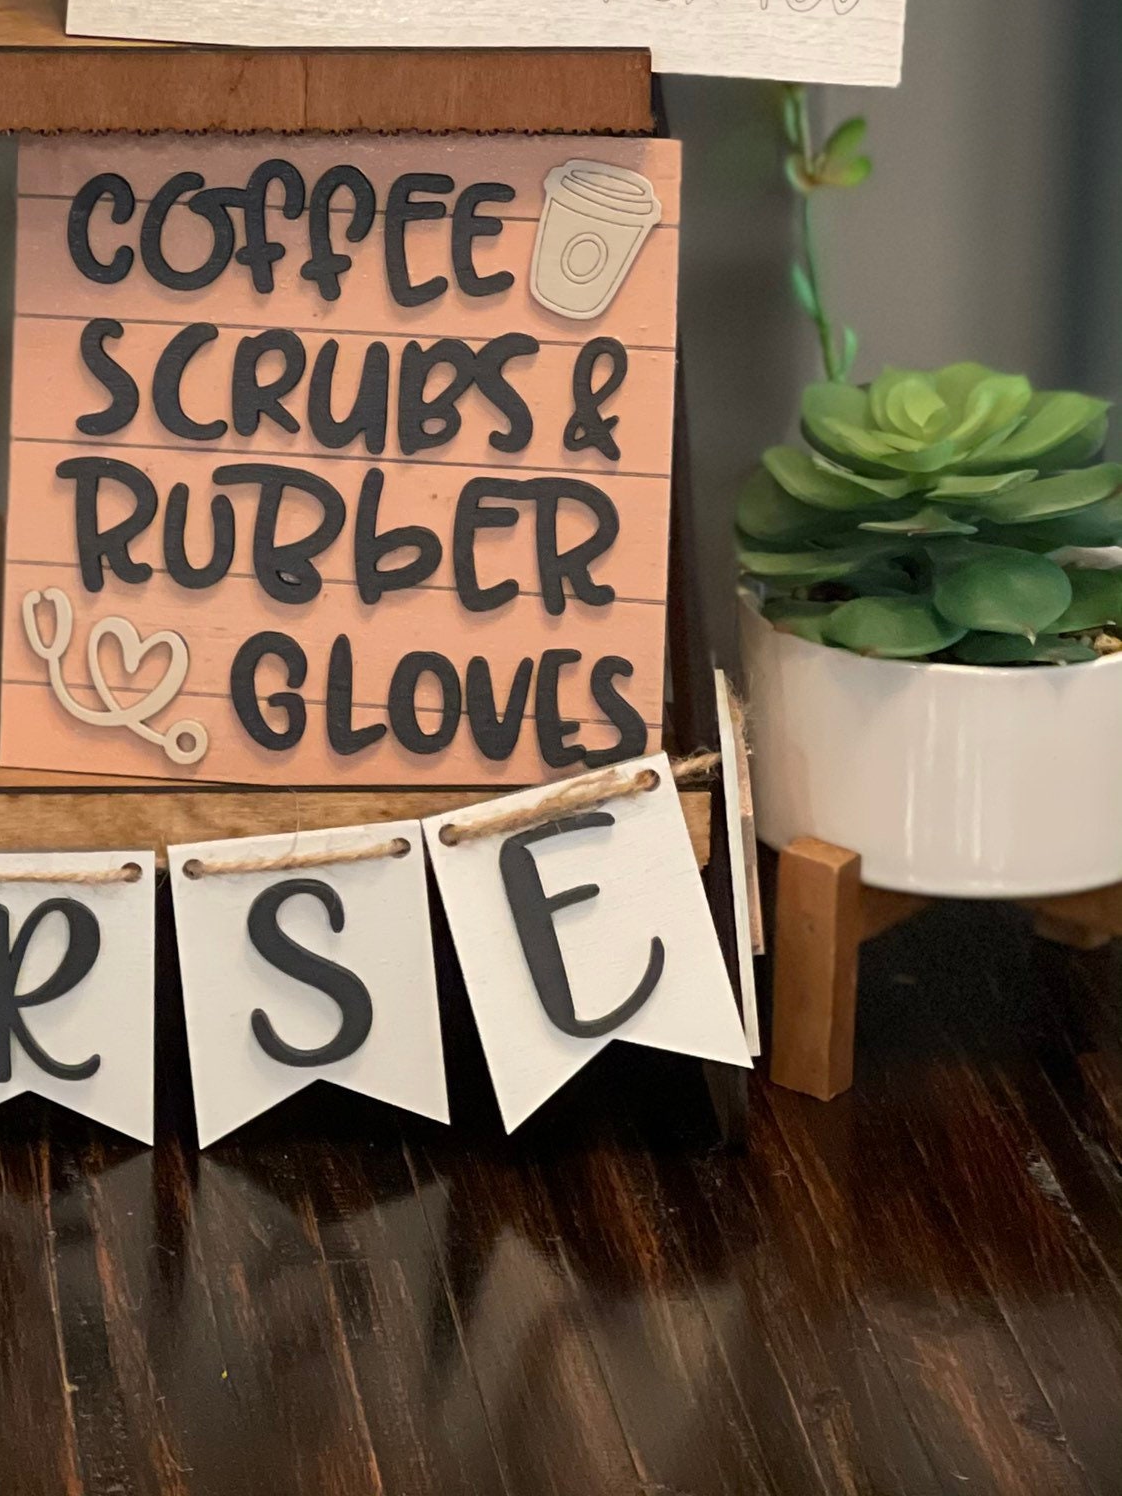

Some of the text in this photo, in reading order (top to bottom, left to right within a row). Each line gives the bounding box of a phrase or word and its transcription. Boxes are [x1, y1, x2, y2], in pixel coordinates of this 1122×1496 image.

[75, 318, 628, 461] SCRUBS &
[230, 631, 648, 768] GLOVES
